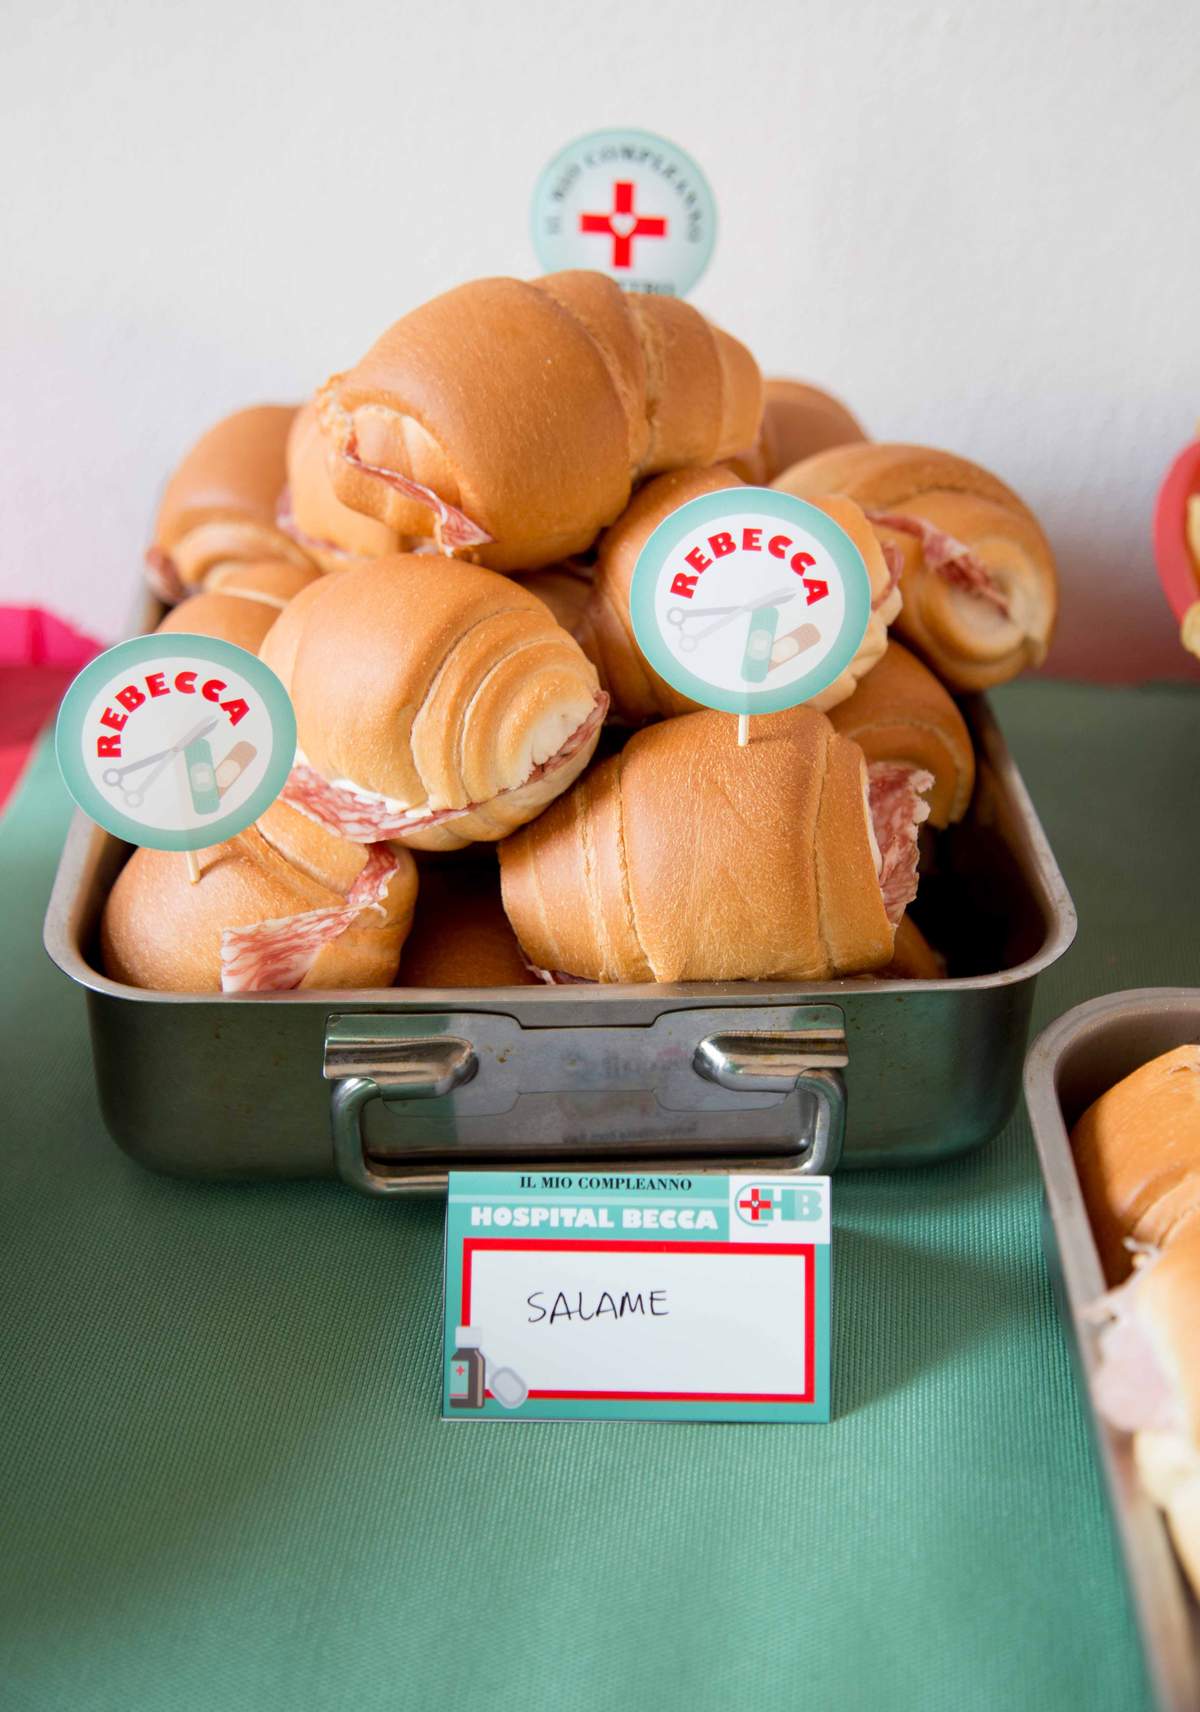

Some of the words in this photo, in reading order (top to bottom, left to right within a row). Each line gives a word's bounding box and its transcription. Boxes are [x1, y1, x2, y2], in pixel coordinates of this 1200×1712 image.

[670, 528, 829, 606] REBECCA
[97, 671, 250, 758] REBECCA
[520, 1176, 536, 1189] IL
[542, 1176, 573, 1190] MIO
[578, 1177, 692, 1191] COMPLEANNO
[471, 1206, 615, 1228] HOSPITAL
[622, 1208, 718, 1230] BECCA
[527, 1290, 670, 1324] SALAME
